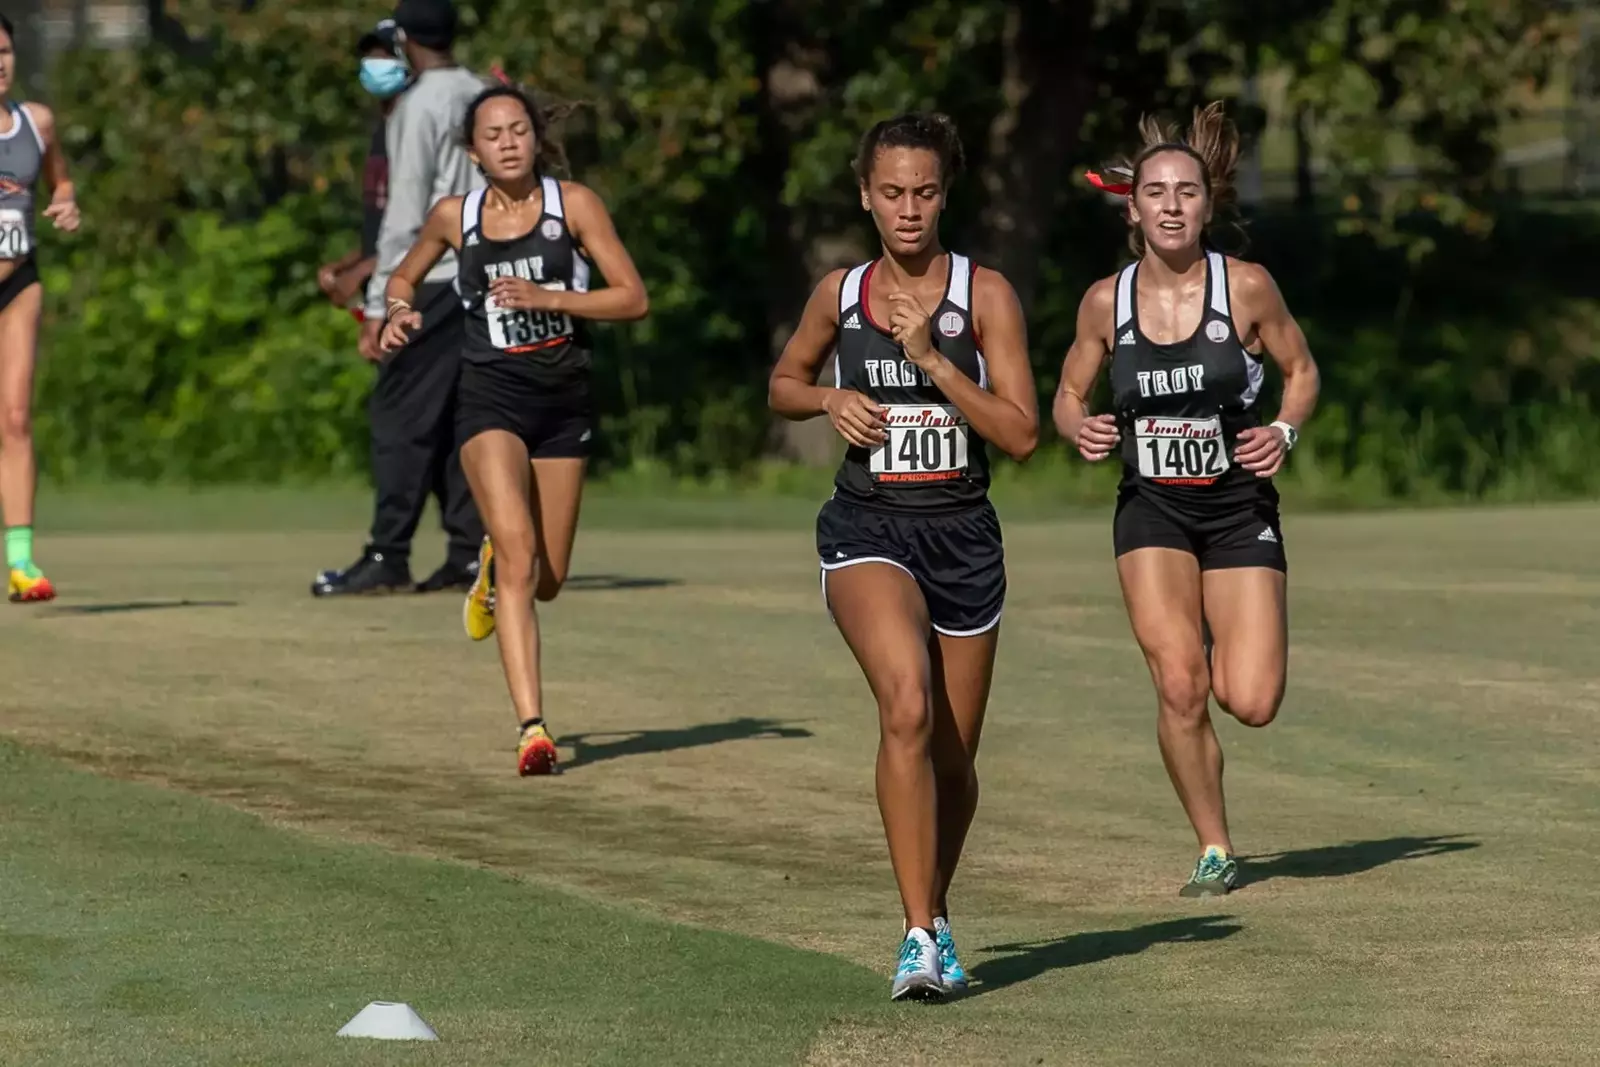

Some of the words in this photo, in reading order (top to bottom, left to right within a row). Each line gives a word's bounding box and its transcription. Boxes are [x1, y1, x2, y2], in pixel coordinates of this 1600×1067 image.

[1137, 364, 1205, 398] TROY
[884, 428, 957, 471] 1401
[1146, 438, 1223, 476] 1402
